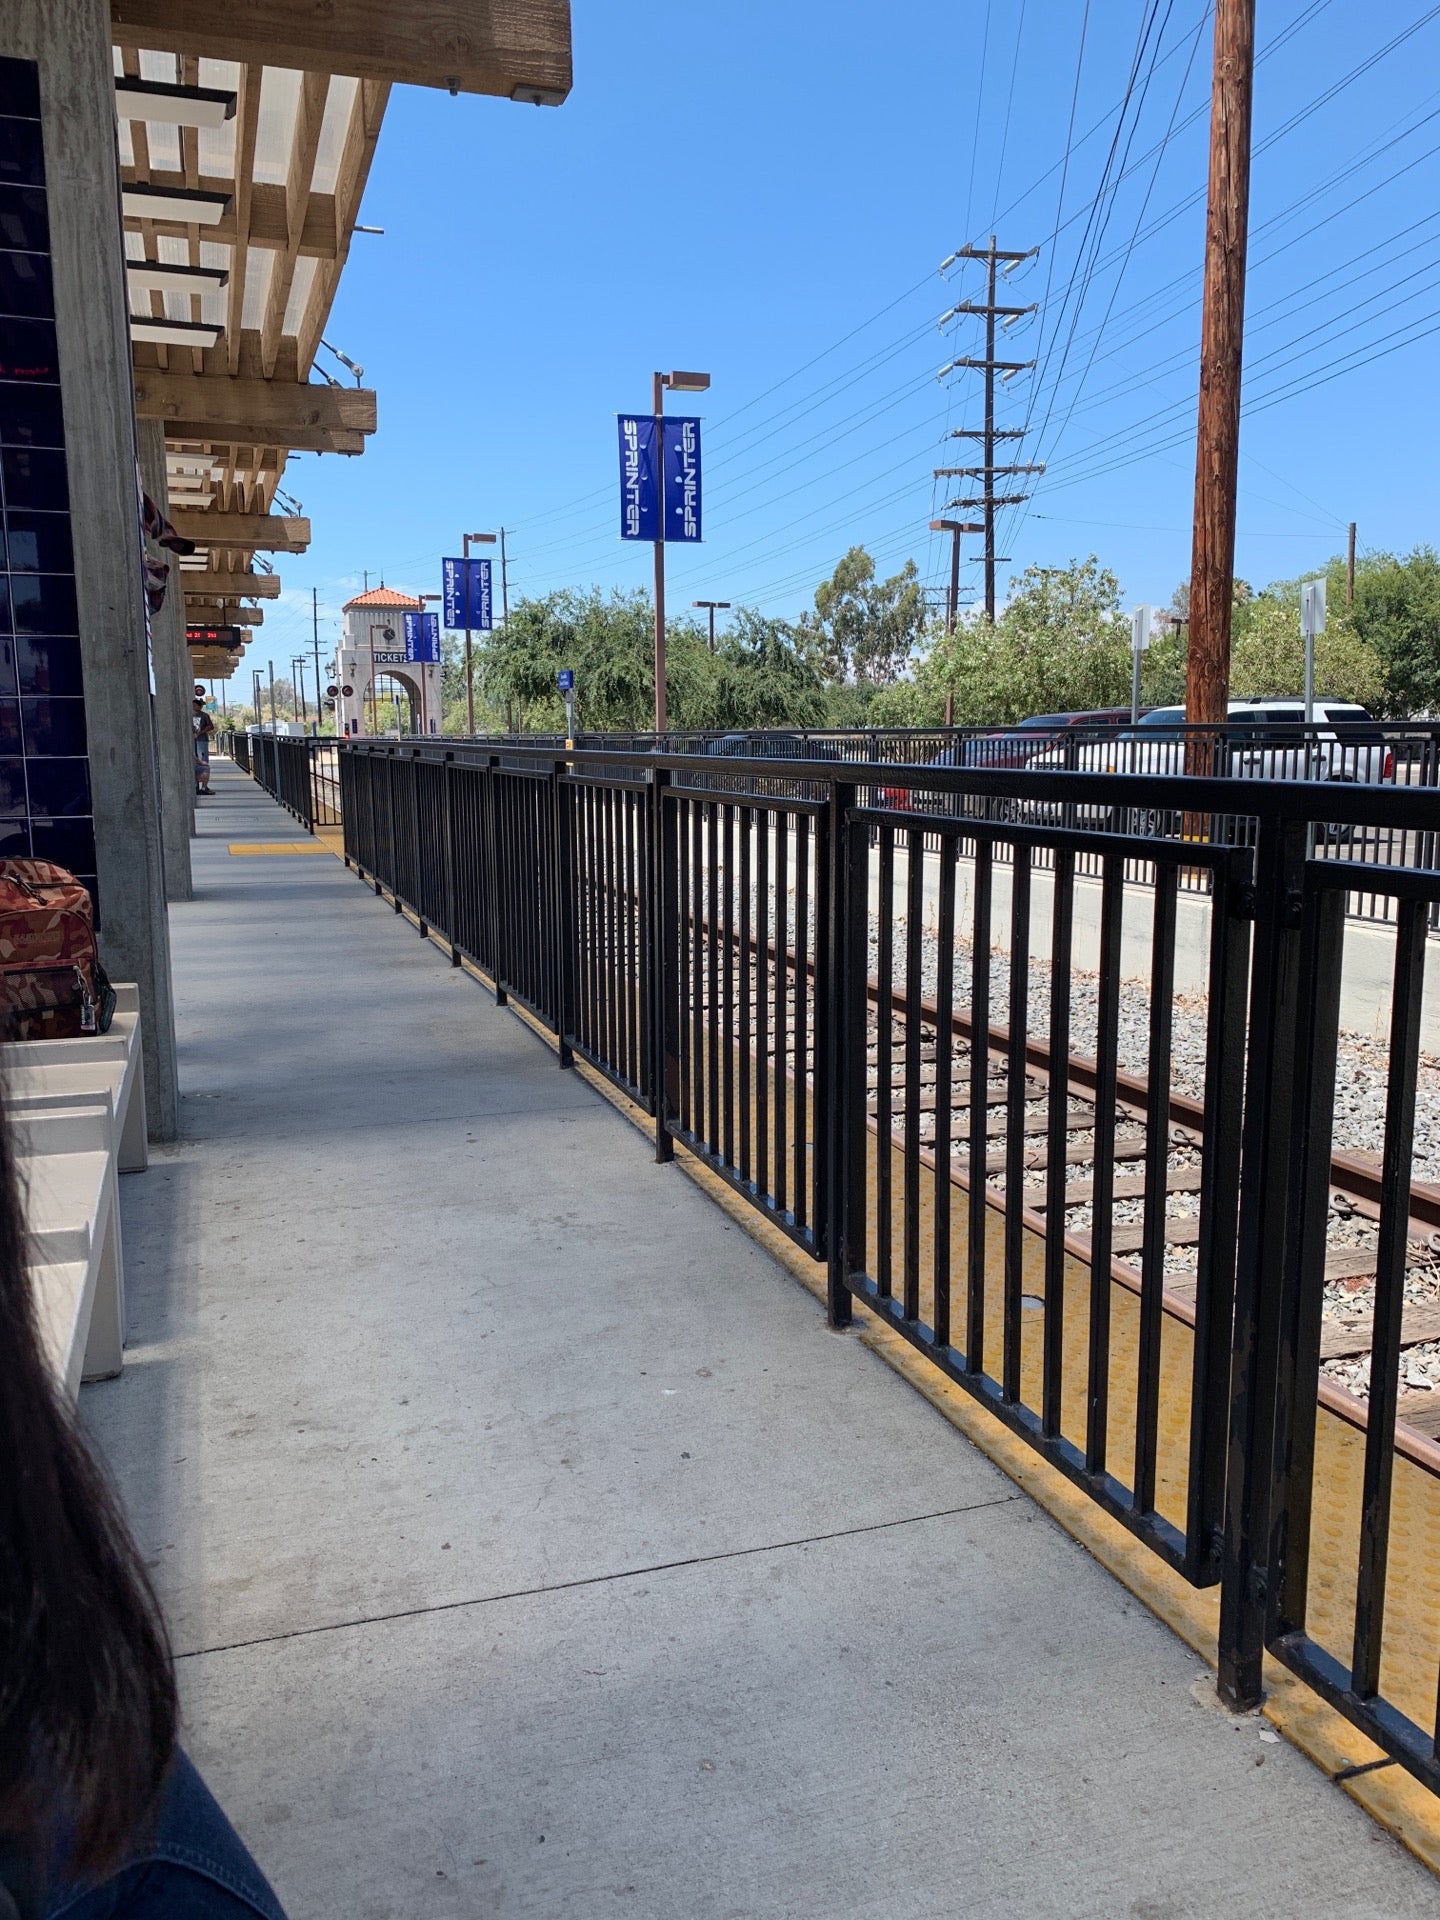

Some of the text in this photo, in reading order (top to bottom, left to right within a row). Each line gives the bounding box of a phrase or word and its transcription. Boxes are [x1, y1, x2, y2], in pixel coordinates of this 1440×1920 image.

[624, 419, 640, 536] SPRINTER
[682, 422, 697, 538] SPRINTER
[445, 559, 455, 627] SPRINTER
[480, 562, 490, 628] SPRINTER
[405, 614, 414, 661] SPRINTER
[430, 614, 439, 661] SPRINTER
